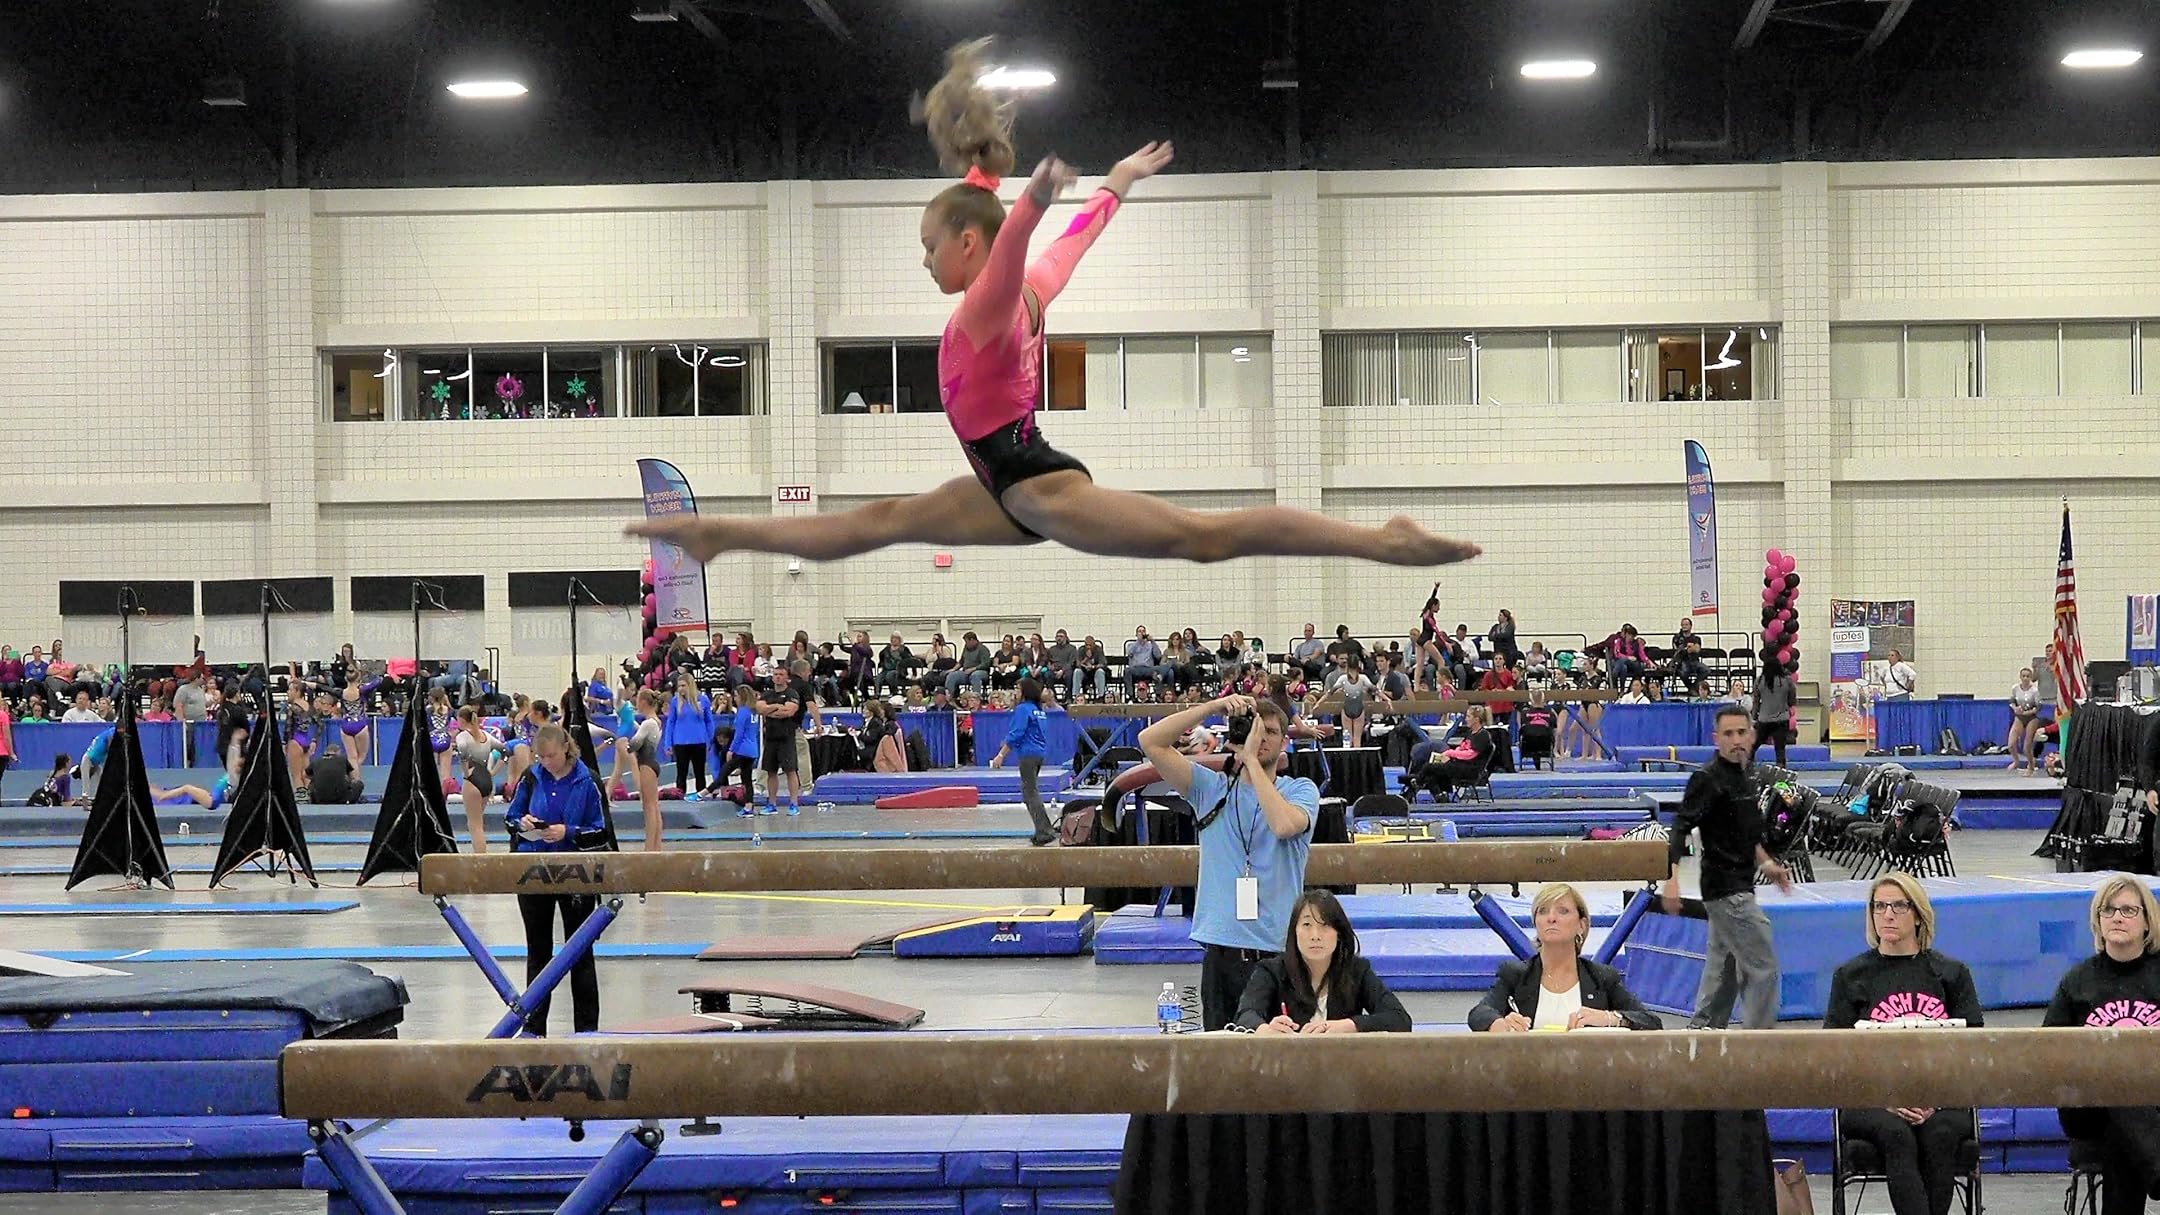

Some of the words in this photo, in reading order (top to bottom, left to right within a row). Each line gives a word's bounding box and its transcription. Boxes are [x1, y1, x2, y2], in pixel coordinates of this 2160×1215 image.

[779, 488, 809, 500] EXIT
[1869, 992, 1913, 1022] EACH
[2084, 1000, 2130, 1027] EACH
[2132, 1001, 2160, 1027] TEA
